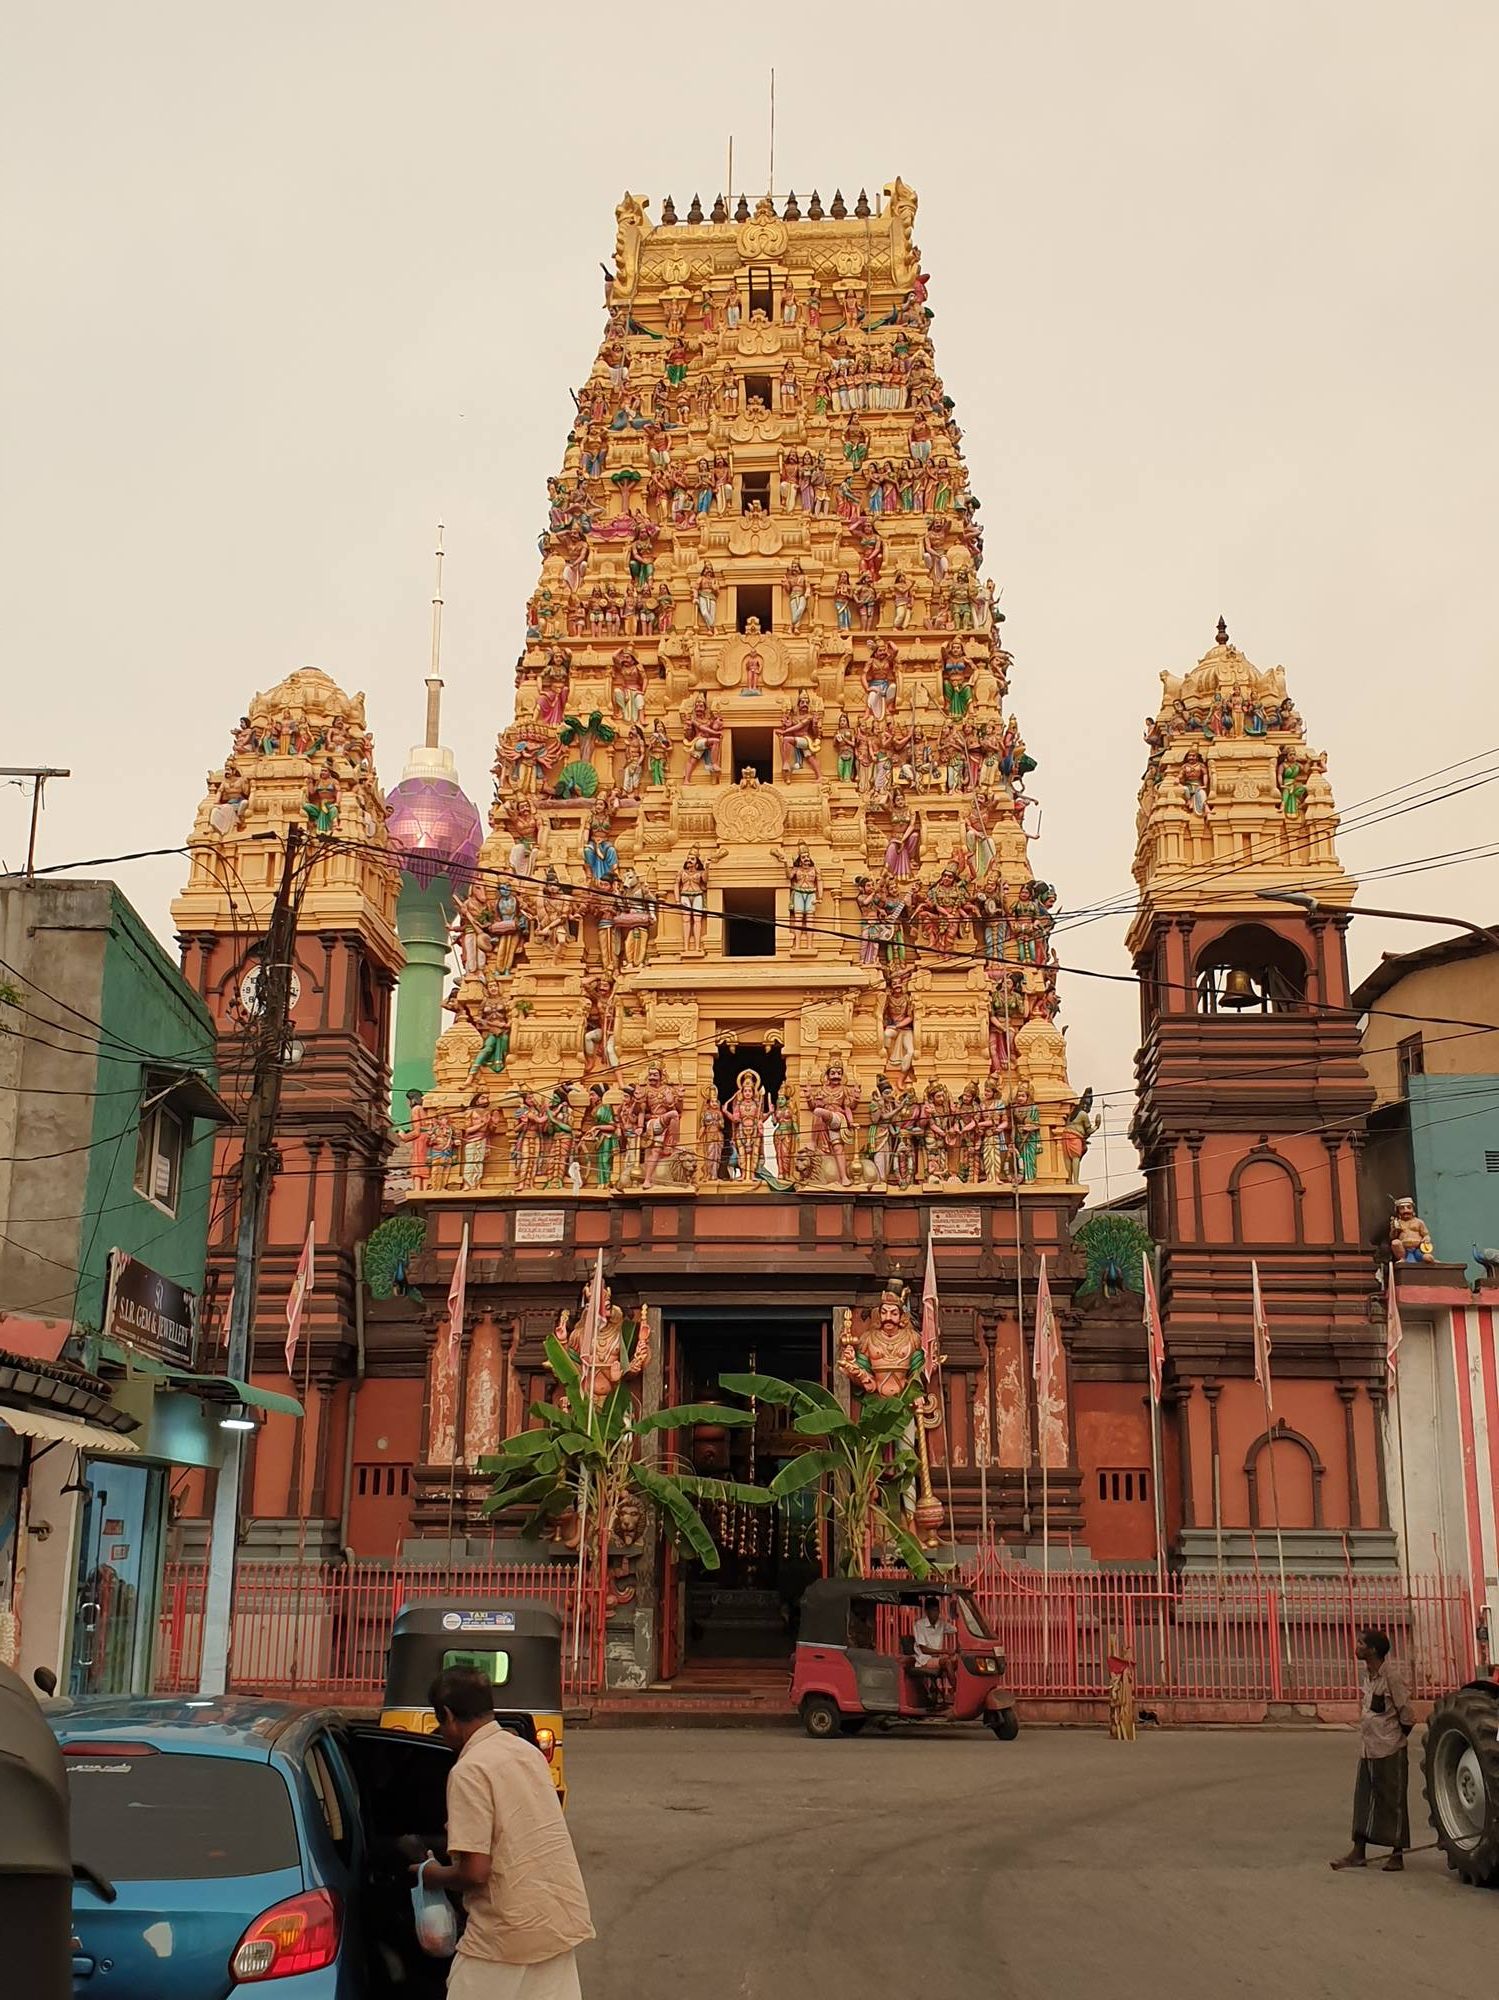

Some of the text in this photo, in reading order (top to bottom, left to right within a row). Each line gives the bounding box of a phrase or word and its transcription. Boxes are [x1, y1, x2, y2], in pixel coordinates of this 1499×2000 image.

[136, 1305, 151, 1332] GEM
[151, 1311, 157, 1334] &
[157, 1314, 190, 1348] JEWELLERY
[469, 1611, 488, 1619] TAXI
